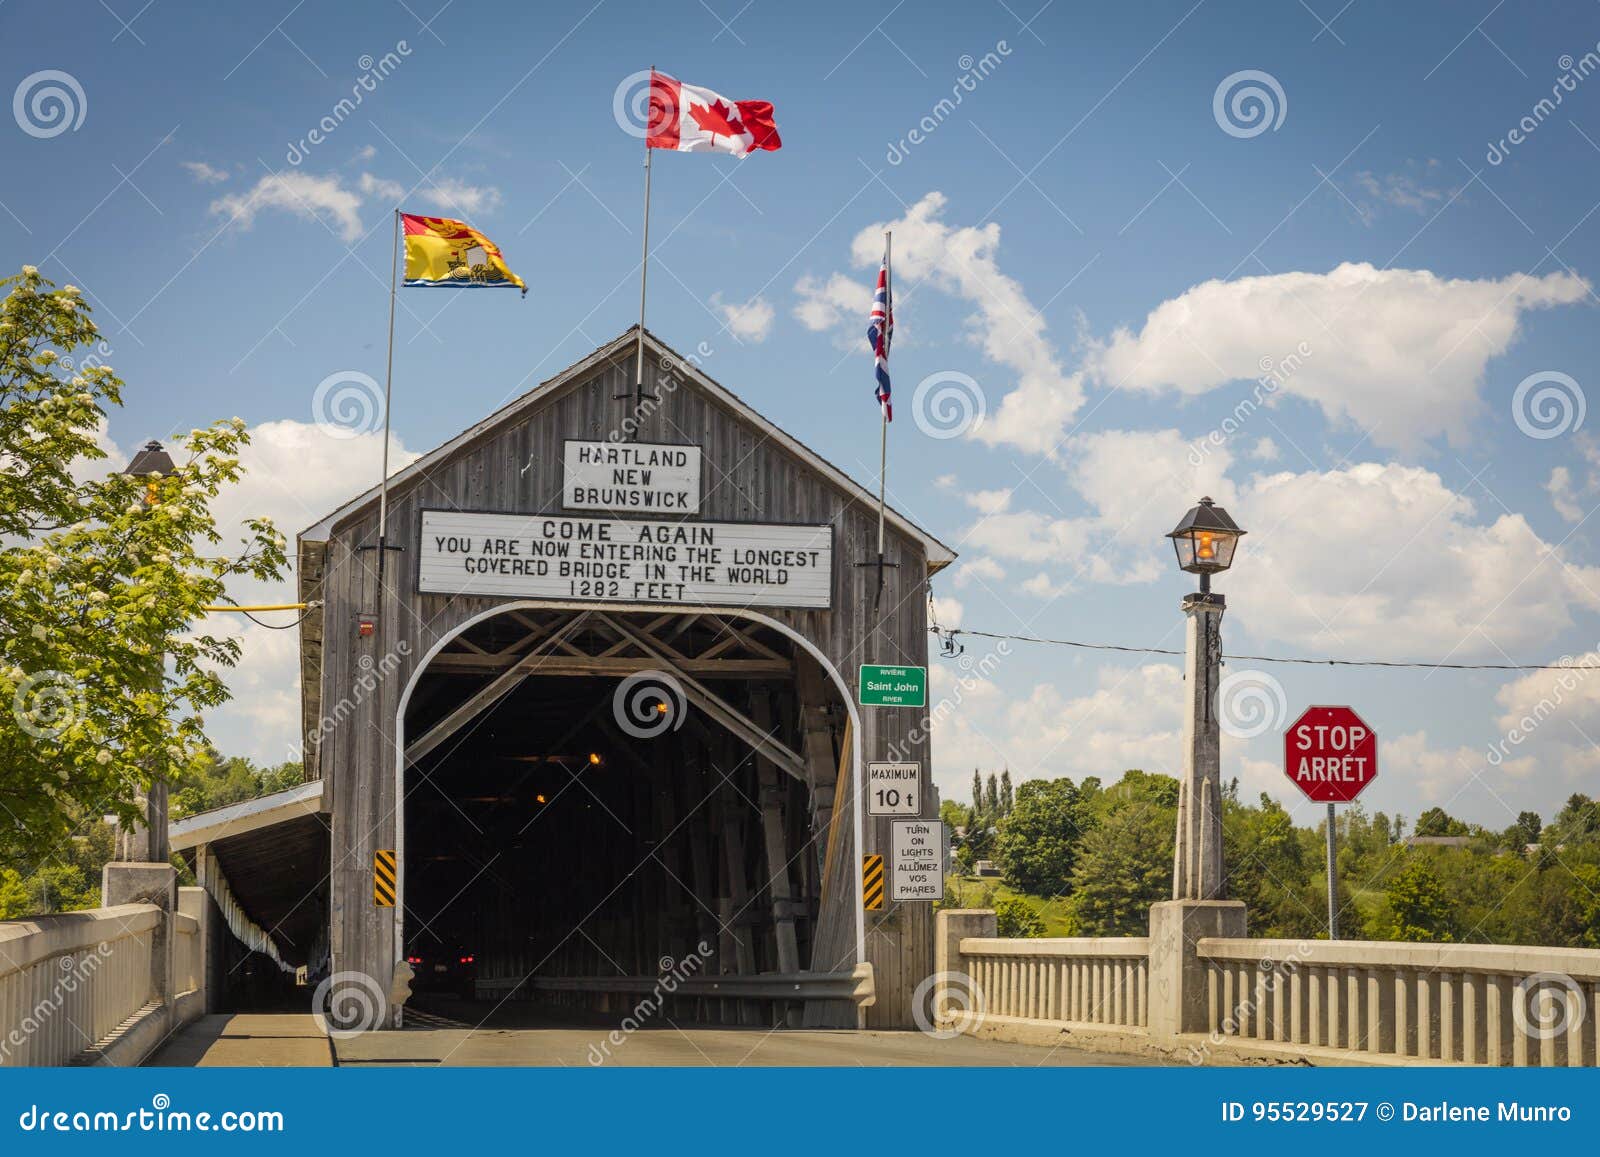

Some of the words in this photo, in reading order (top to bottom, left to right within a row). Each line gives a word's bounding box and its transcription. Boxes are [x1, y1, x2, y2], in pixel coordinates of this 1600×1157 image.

[580, 447, 687, 467] HARTLAND
[613, 469, 651, 486] NEW
[574, 487, 688, 508] BRUNSWICK
[543, 520, 611, 541] COME
[638, 525, 714, 546] AGAIN
[435, 536, 471, 553] YOU
[483, 538, 520, 556] ARE
[531, 540, 569, 558] NOW
[580, 543, 677, 563] ENTERING
[685, 547, 722, 565] THE
[734, 548, 820, 568] LONGEST
[560, 561, 631, 580] BRIDGE
[645, 563, 666, 580] IN
[678, 565, 716, 583] THE
[728, 566, 789, 585] WORLD
[570, 580, 619, 597] 1282
[634, 582, 686, 601] FEET
[867, 681, 892, 691] Saint
[894, 682, 919, 692] John
[882, 695, 903, 703] RIVER
[1296, 725, 1366, 751] STOP
[871, 768, 917, 780] MAXIMUM
[1296, 754, 1368, 782] ARRÊT
[875, 789, 900, 807] 10
[906, 793, 913, 807] t
[905, 826, 930, 834] TURN
[911, 837, 924, 846] ON
[901, 848, 934, 857] LIGHTS
[909, 874, 928, 883] VOS
[900, 886, 936, 894] PHARES
